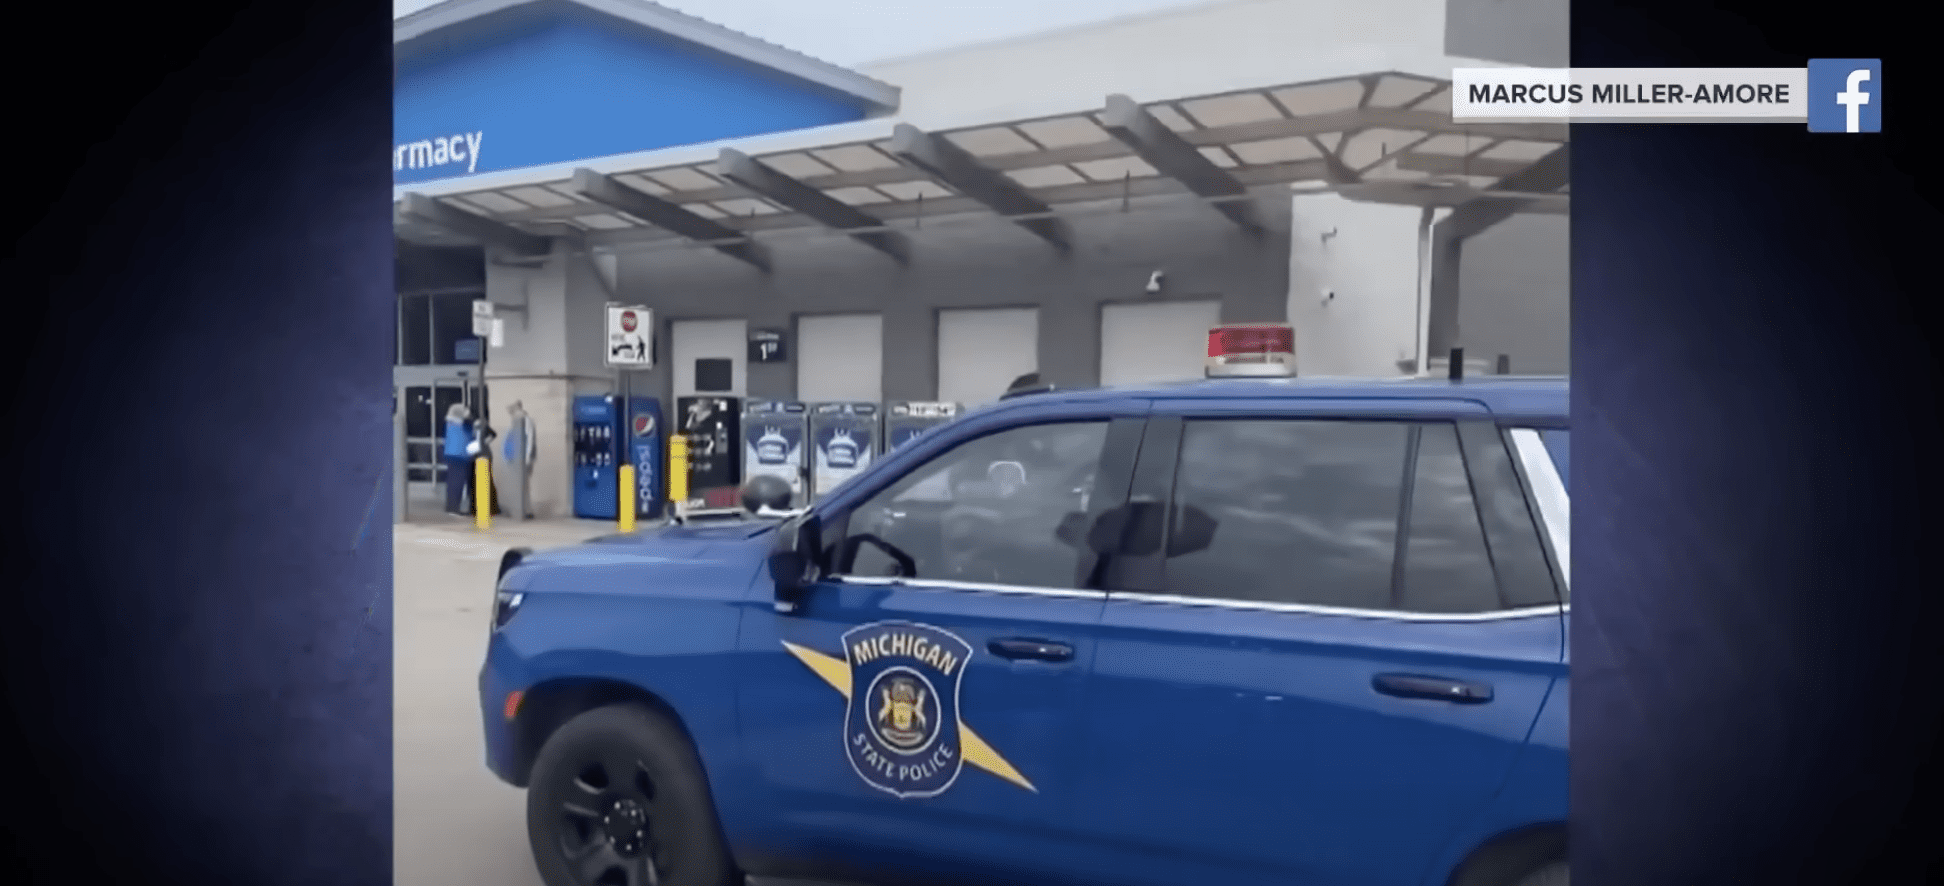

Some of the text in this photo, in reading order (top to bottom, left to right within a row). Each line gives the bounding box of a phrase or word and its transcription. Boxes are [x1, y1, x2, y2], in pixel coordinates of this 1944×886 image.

[853, 633, 958, 676] MICHIGAN
[853, 732, 953, 781] STATE POLICE
